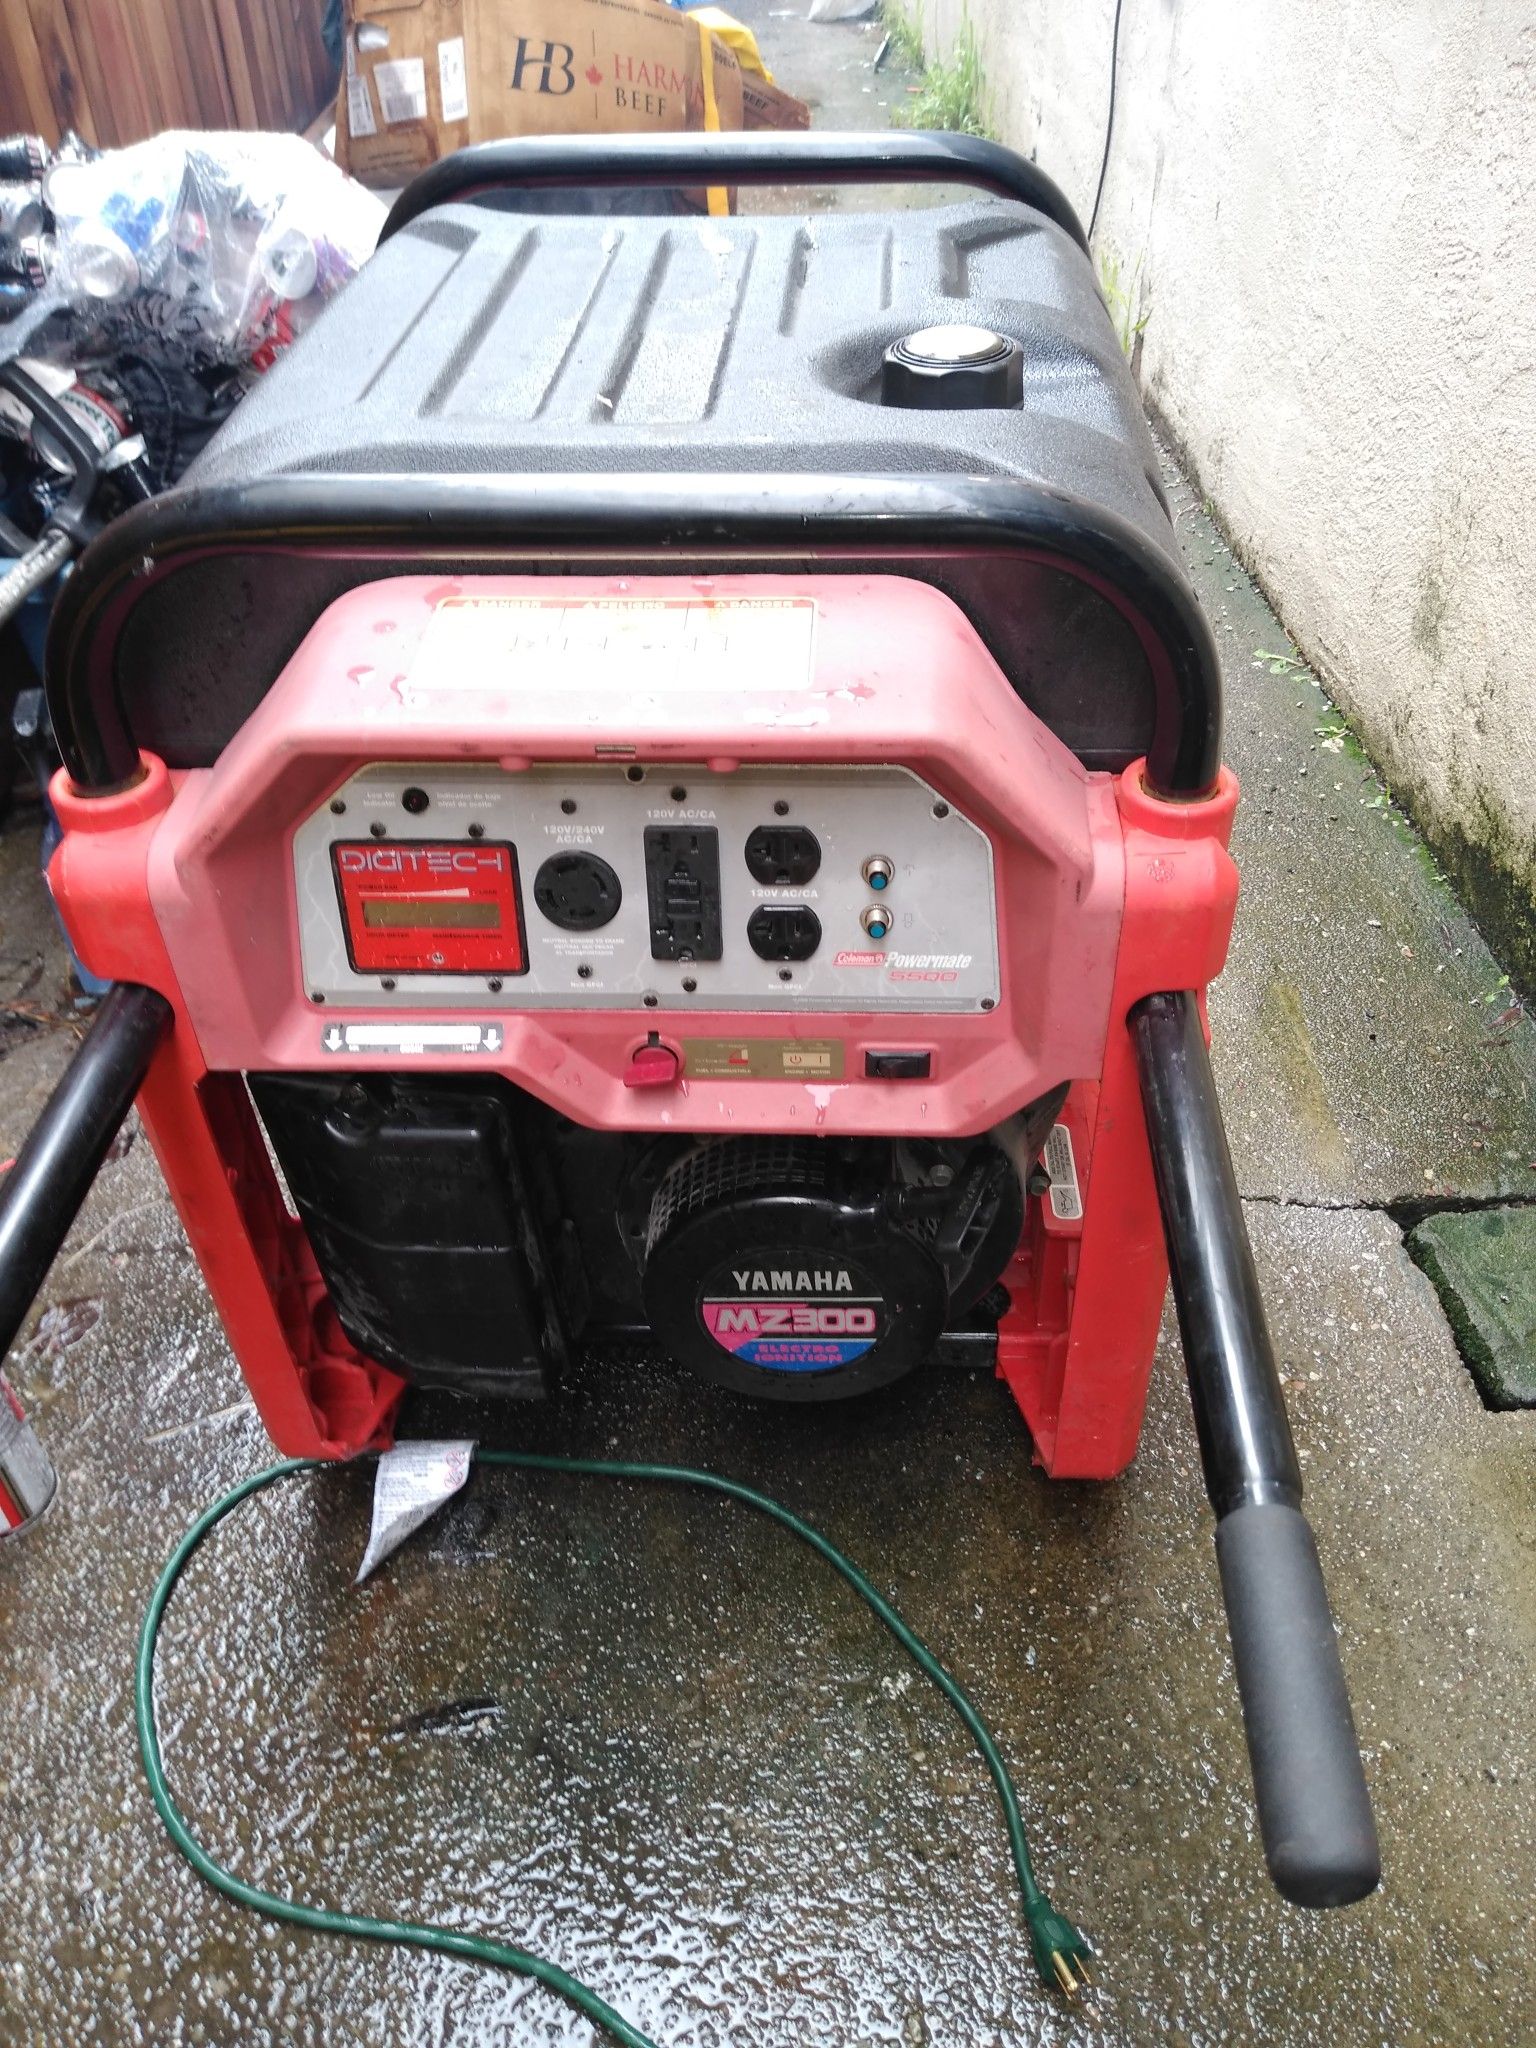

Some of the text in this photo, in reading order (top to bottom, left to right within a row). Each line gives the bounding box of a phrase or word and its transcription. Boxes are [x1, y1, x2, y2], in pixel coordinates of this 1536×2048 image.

[509, 36, 575, 95] HB
[615, 87, 667, 117] BEEF
[647, 809, 716, 819] 120V AC/CA
[544, 825, 605, 835] 120V/240V
[556, 835, 593, 844] AC/CA
[341, 849, 504, 873] DIGITECH
[750, 889, 819, 899] 120V AC/CA
[837, 951, 972, 969] Coleman Powermate
[889, 971, 960, 982] 5500
[732, 1270, 853, 1291] YAMAHA
[716, 1307, 877, 1334] MZ300
[758, 1344, 840, 1353] ELECTRO
[754, 1353, 843, 1362] IGNITION
